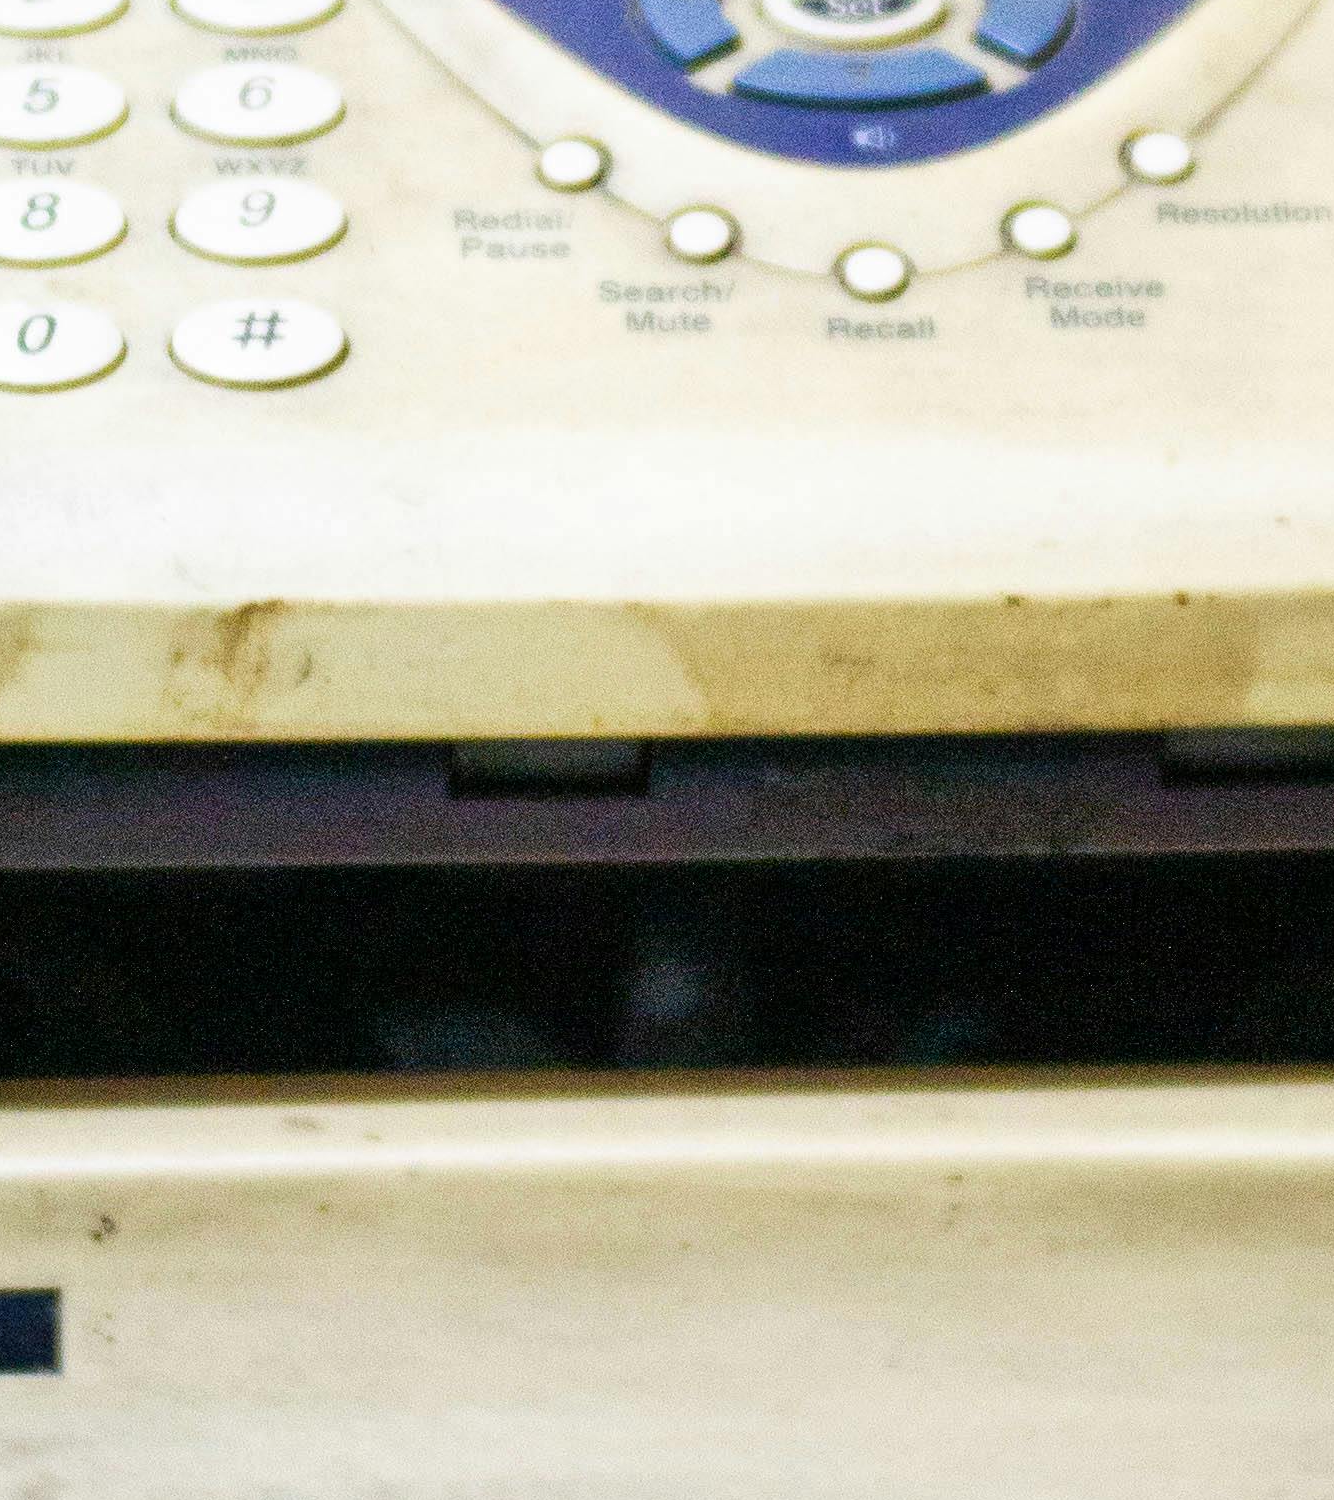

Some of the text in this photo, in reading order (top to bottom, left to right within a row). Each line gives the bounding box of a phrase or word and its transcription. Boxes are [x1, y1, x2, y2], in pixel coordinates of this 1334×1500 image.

[23, 78, 60, 114] 5
[237, 76, 272, 111] 6
[20, 191, 60, 230] 8
[238, 190, 276, 228] 9
[1156, 200, 1334, 226] Resolution
[461, 235, 572, 261] Pause
[1026, 273, 1165, 301] Receive
[232, 312, 285, 348] #
[626, 308, 712, 335] Mute
[825, 315, 936, 341] Recall
[1051, 302, 1147, 330] Mode
[17, 314, 57, 355] 0
